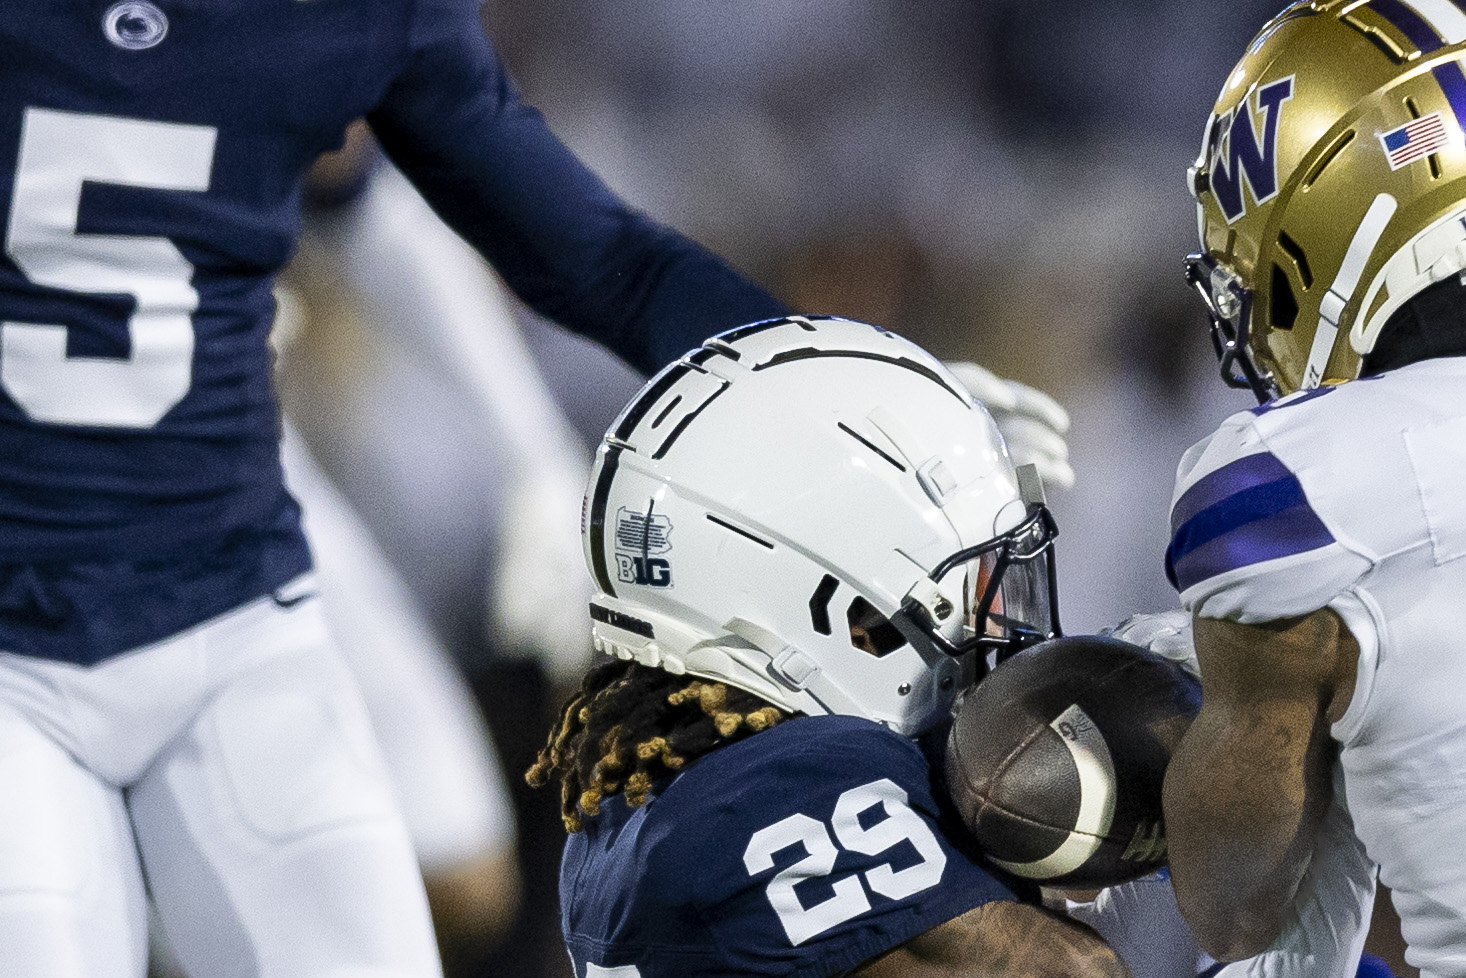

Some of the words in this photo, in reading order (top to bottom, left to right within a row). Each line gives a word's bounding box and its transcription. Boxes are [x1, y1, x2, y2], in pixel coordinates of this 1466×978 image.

[1210, 73, 1296, 225] W
[0, 106, 218, 429] 5
[742, 777, 948, 947] 29
